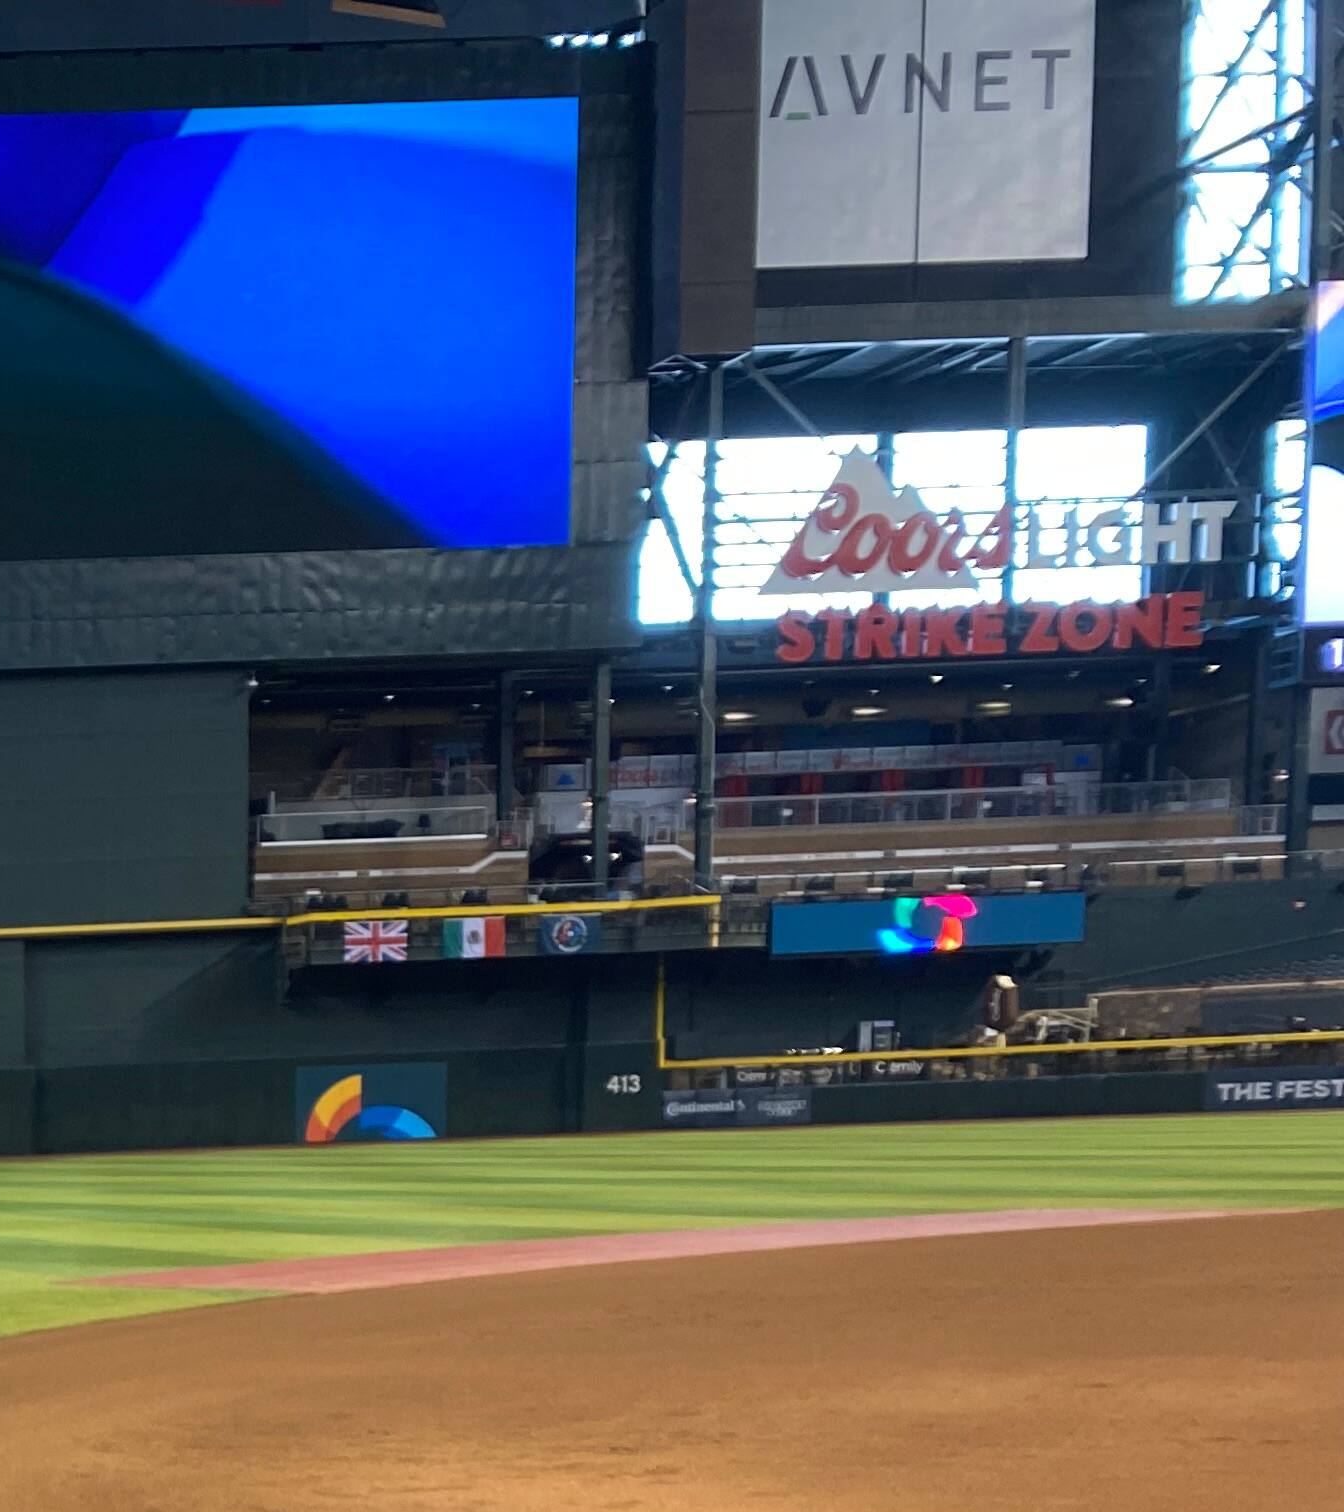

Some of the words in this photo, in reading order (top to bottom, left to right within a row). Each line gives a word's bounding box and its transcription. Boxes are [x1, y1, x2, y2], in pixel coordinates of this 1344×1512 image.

[769, 48, 1072, 121] AVNET
[780, 482, 1012, 579] Coors
[1026, 497, 1238, 569] LIGHT
[775, 603, 1009, 663] STRIKE
[1018, 591, 1206, 654] ZONE
[606, 1073, 642, 1094] 413
[1216, 1081, 1273, 1101] THE
[1276, 1078, 1344, 1099] FEST
[666, 1100, 735, 1117] Continental
